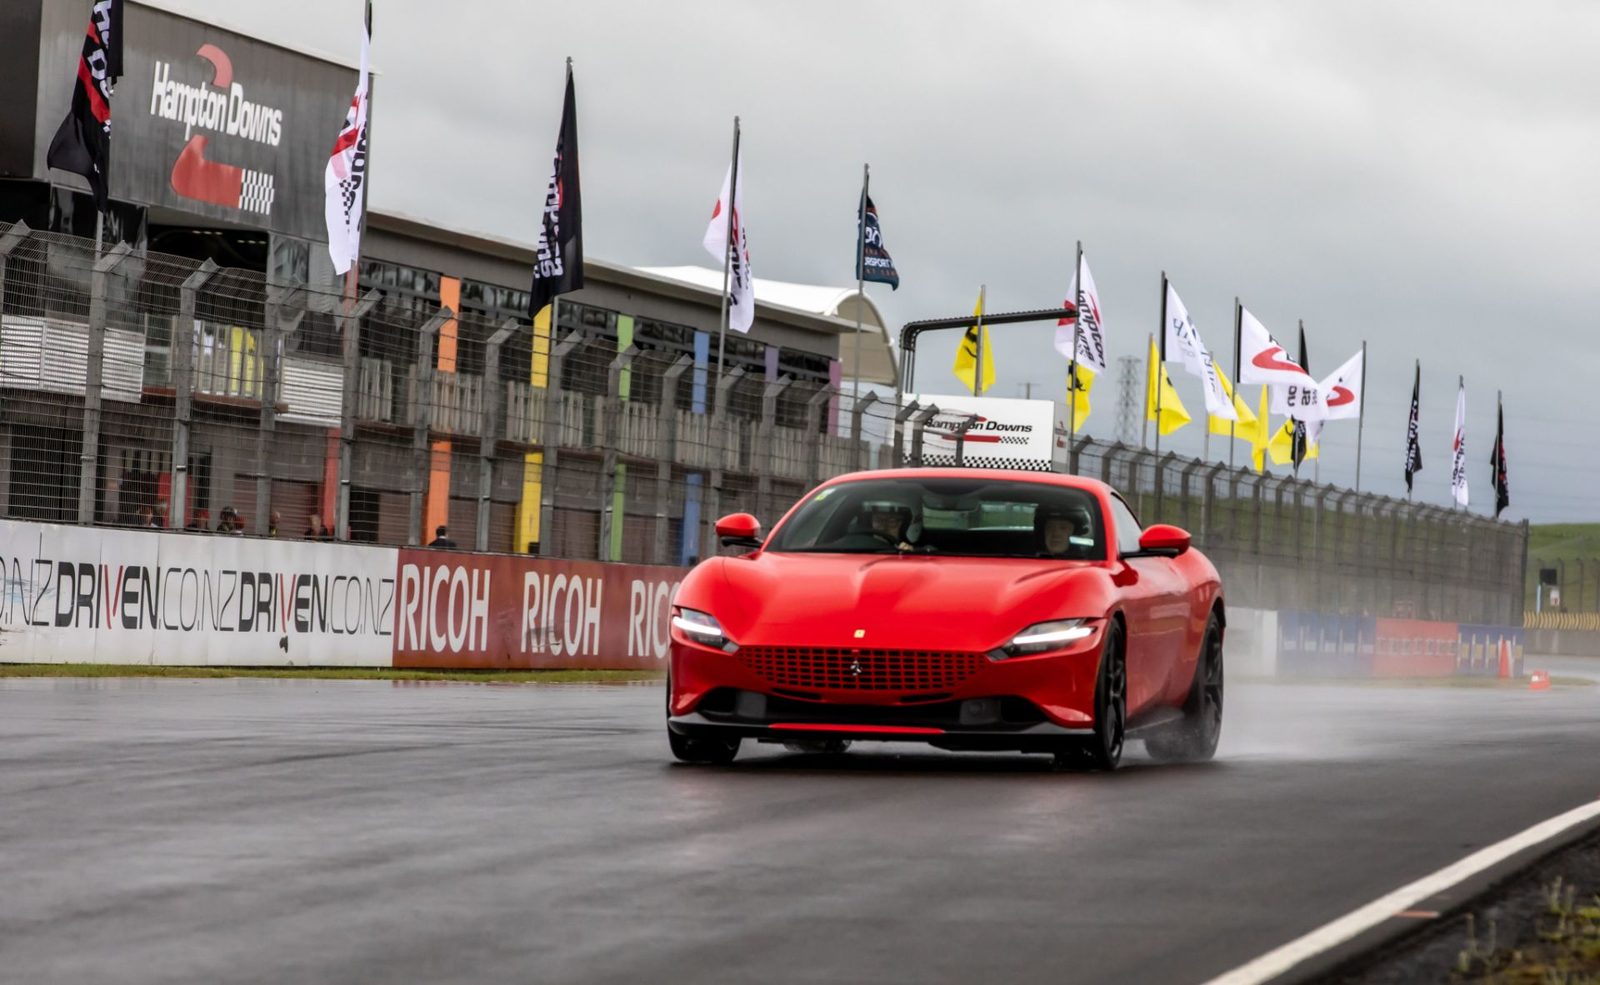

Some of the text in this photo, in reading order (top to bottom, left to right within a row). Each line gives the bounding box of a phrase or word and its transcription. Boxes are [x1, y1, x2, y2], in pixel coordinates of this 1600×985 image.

[150, 61, 283, 147] Hampton Downs
[986, 421, 1033, 432] Downs
[398, 563, 680, 659] RICOH RICOH RIC
